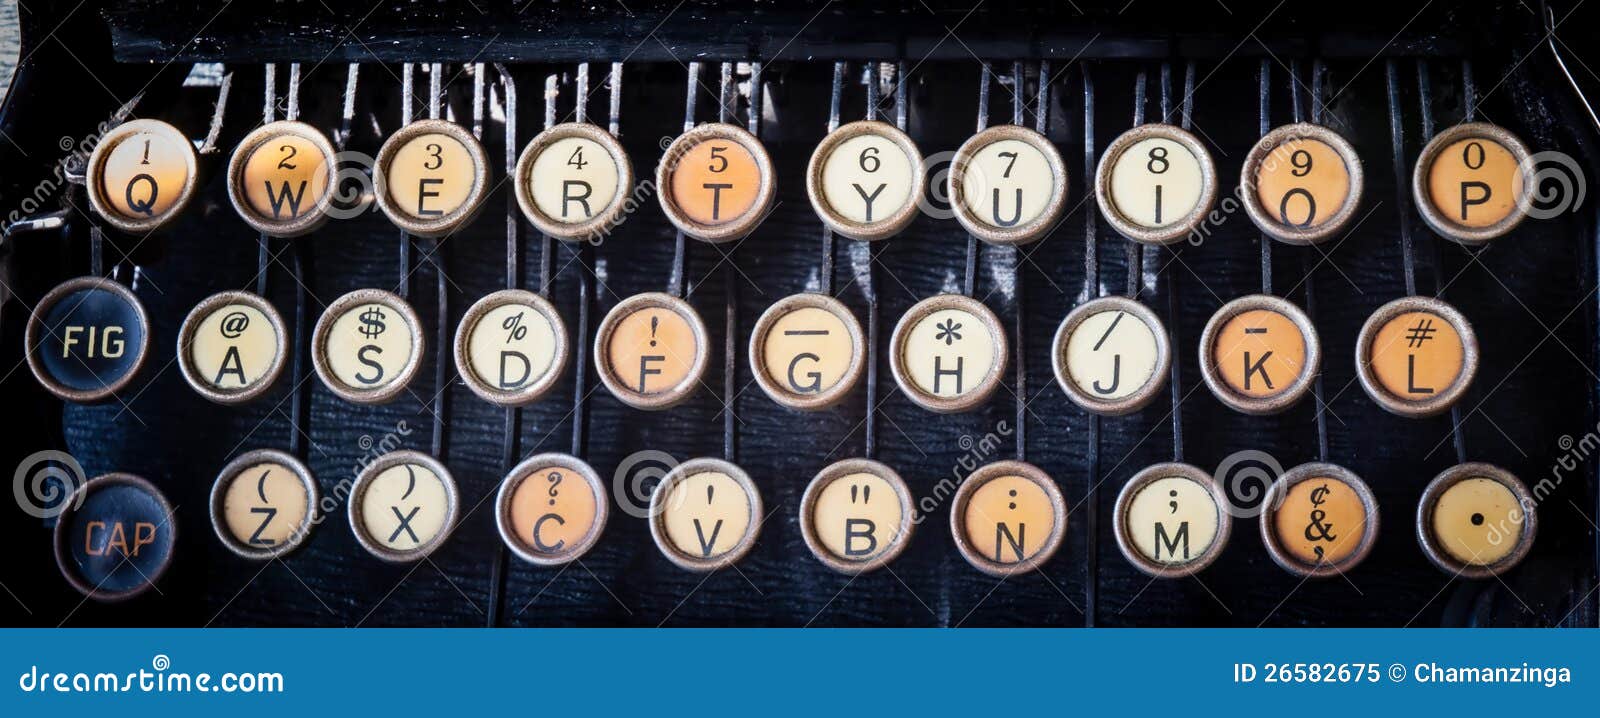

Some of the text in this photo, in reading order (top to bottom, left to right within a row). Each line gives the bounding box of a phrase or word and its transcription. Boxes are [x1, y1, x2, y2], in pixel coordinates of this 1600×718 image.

[140, 139, 151, 165] 1
[277, 145, 297, 170] 2
[423, 143, 443, 171] 3
[567, 146, 589, 170] 4
[708, 146, 729, 173] 5
[859, 146, 881, 173] 6
[997, 151, 1019, 179] 7
[1146, 146, 1170, 175] 8
[1290, 149, 1313, 178] 9
[1462, 141, 1486, 170] 0
[125, 173, 159, 217] Q
[264, 179, 307, 219] W
[418, 178, 444, 216] E
[561, 179, 593, 218] R
[702, 183, 733, 221] T
[851, 183, 888, 222] Y
[992, 187, 1023, 227] U
[1154, 184, 1163, 225] I
[1279, 187, 1317, 229] O
[1460, 180, 1492, 221] P
[219, 311, 250, 339] @
[357, 306, 386, 340] $
[502, 311, 528, 344] %
[650, 316, 658, 348] !
[1405, 318, 1437, 349] #
[62, 325, 126, 360] FIG
[213, 345, 247, 385] A
[354, 344, 384, 385] S
[499, 350, 532, 389] D
[638, 355, 666, 393] F
[787, 352, 822, 393] G
[933, 355, 964, 395] H
[1092, 354, 1121, 395] J
[1243, 350, 1275, 391] K
[1407, 354, 1434, 394] L
[257, 469, 271, 504] (
[401, 462, 416, 501] )
[547, 471, 562, 506] ?
[84, 520, 157, 558] CAP
[247, 507, 278, 545] Z
[388, 506, 421, 543] X
[532, 512, 566, 553] C
[693, 518, 724, 557] V
[844, 518, 877, 556] B
[995, 521, 1026, 562] N
[1154, 521, 1190, 560] M
[1304, 509, 1337, 543] &
